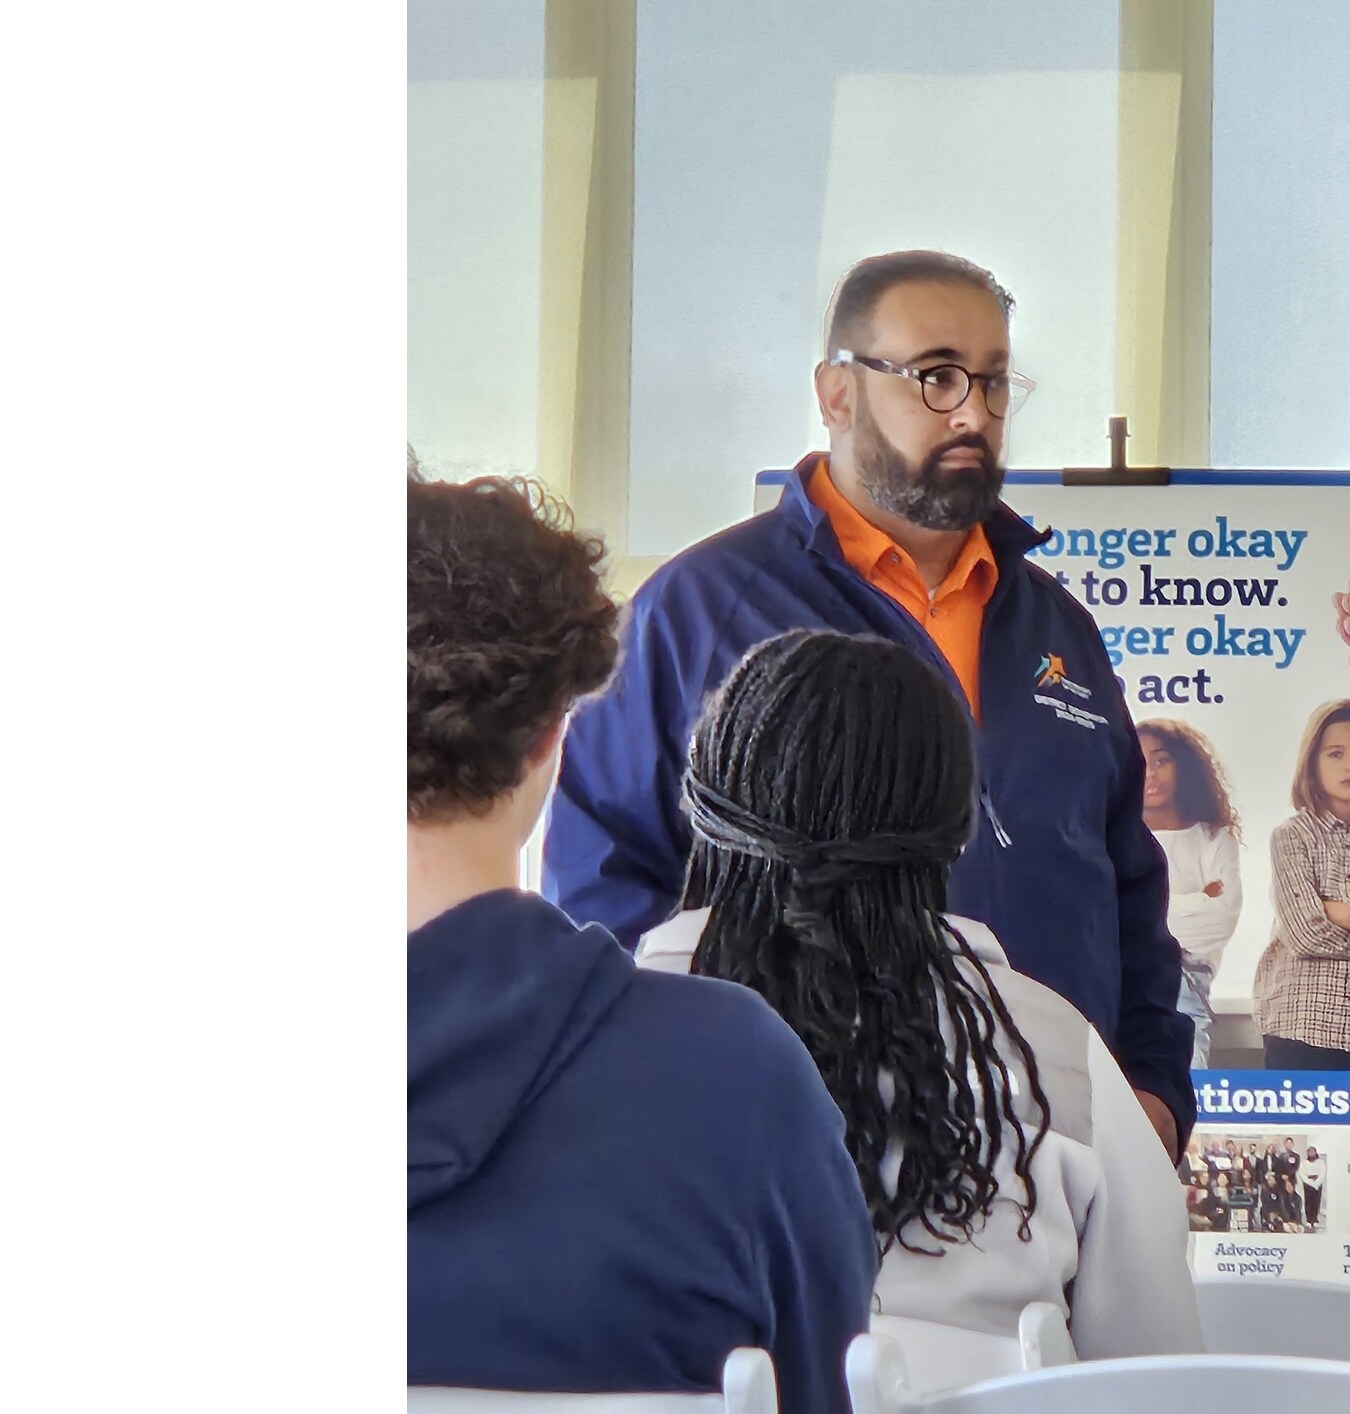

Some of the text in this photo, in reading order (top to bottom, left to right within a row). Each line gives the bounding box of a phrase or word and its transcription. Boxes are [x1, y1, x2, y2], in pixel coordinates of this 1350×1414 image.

[1187, 516, 1308, 569] okay
[1081, 564, 1288, 606] to know.
[1186, 614, 1306, 668] okay
[1138, 668, 1224, 704] act.
[1215, 1242, 1287, 1260] Advocacy
[1217, 1258, 1284, 1276] on policy
